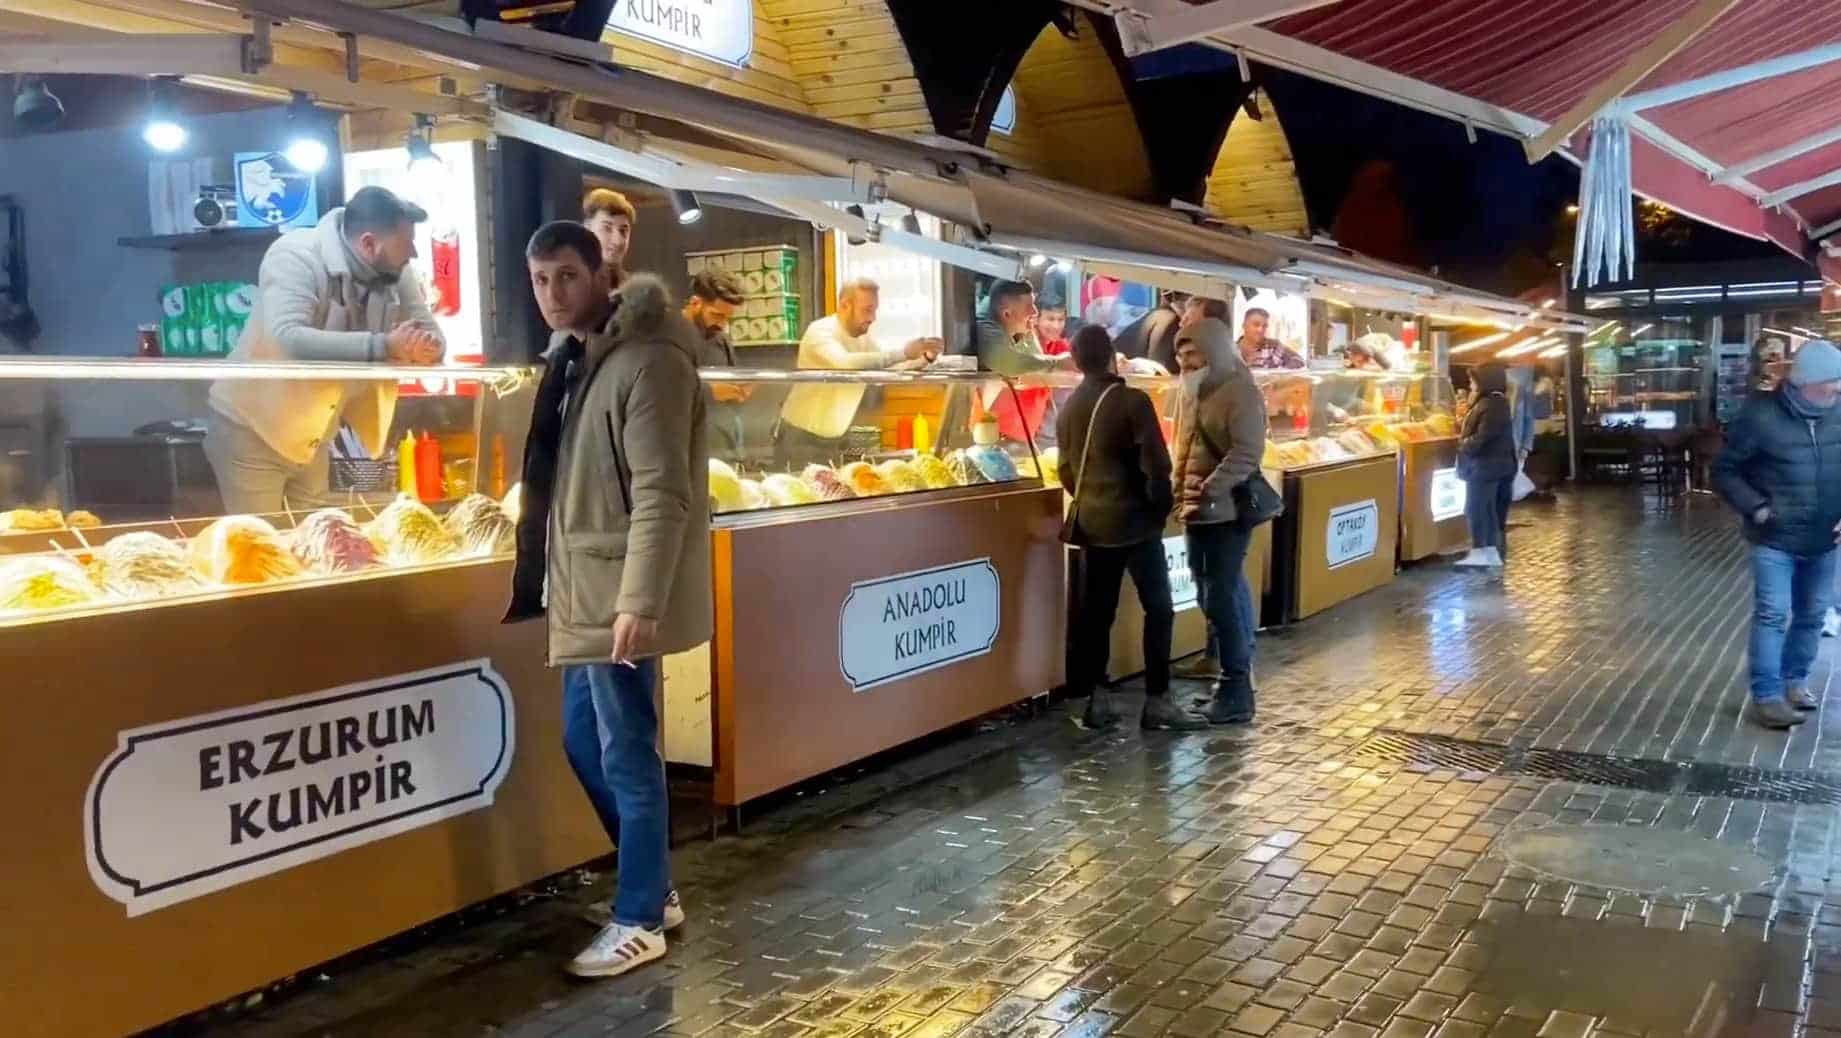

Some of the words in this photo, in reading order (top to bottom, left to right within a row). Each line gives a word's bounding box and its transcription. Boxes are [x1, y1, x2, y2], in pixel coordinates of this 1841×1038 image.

[883, 578, 966, 623] ANADOLU
[895, 615, 957, 661] KUMPİR
[199, 699, 436, 791] ERZURUM
[229, 753, 417, 846] KUMPİR
